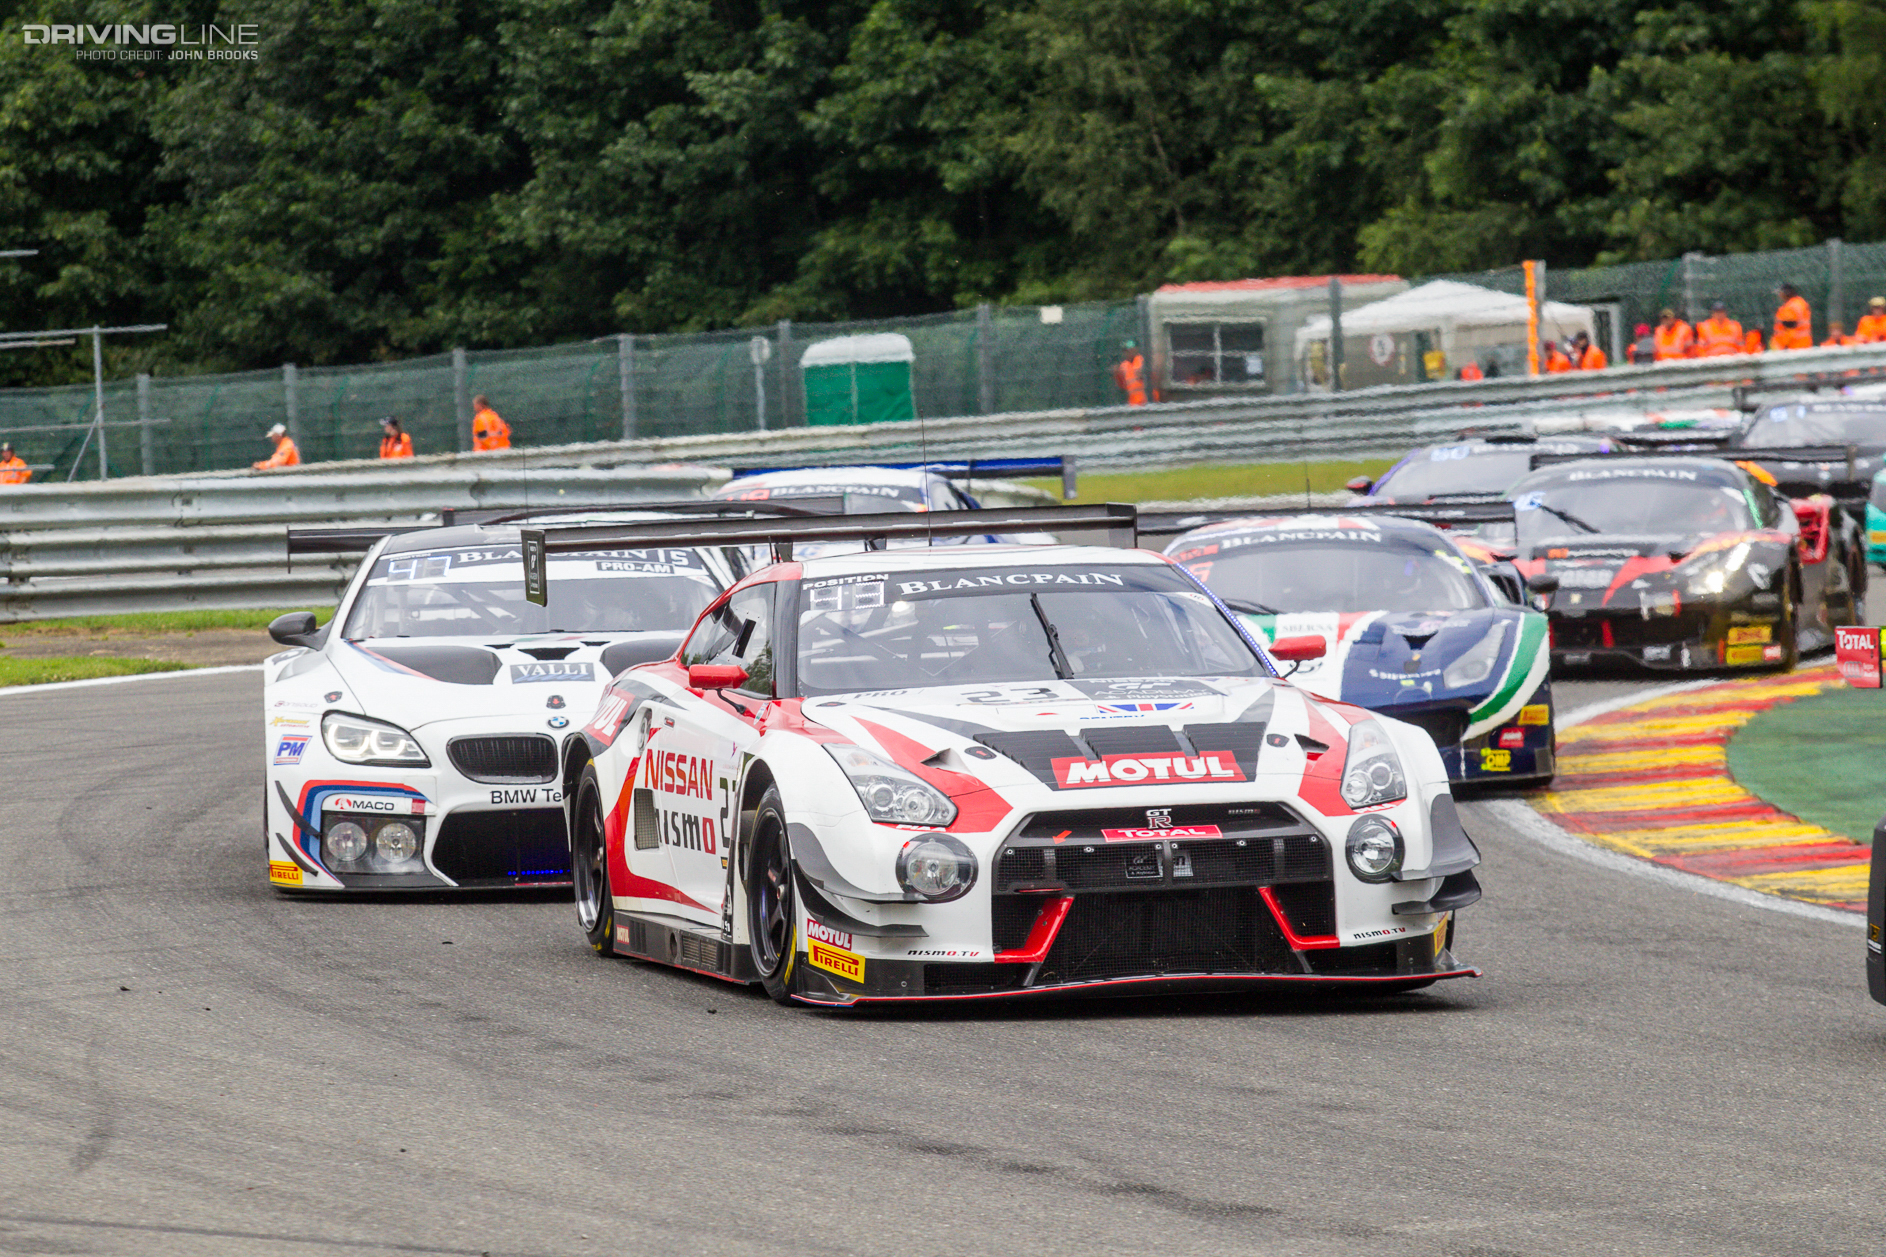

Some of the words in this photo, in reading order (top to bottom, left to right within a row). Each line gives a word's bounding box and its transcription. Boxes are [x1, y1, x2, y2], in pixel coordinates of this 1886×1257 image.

[601, 561, 671, 574] PRO-AM
[802, 574, 889, 591] POSITION
[896, 572, 1124, 596] BLANCPAIN
[1836, 630, 1875, 650] TOTAL
[517, 663, 589, 676] VALLI
[960, 687, 1060, 703] 23
[276, 741, 306, 757] PM
[644, 748, 714, 801] NISSAN
[1065, 756, 1234, 785] MOTUL
[491, 789, 537, 804] BMW
[352, 800, 395, 811] MACO
[1118, 828, 1206, 838] TOTAL
[270, 864, 299, 880] PIRELLI
[807, 922, 852, 950] MOTUL
[813, 945, 860, 977] PIRELLI
